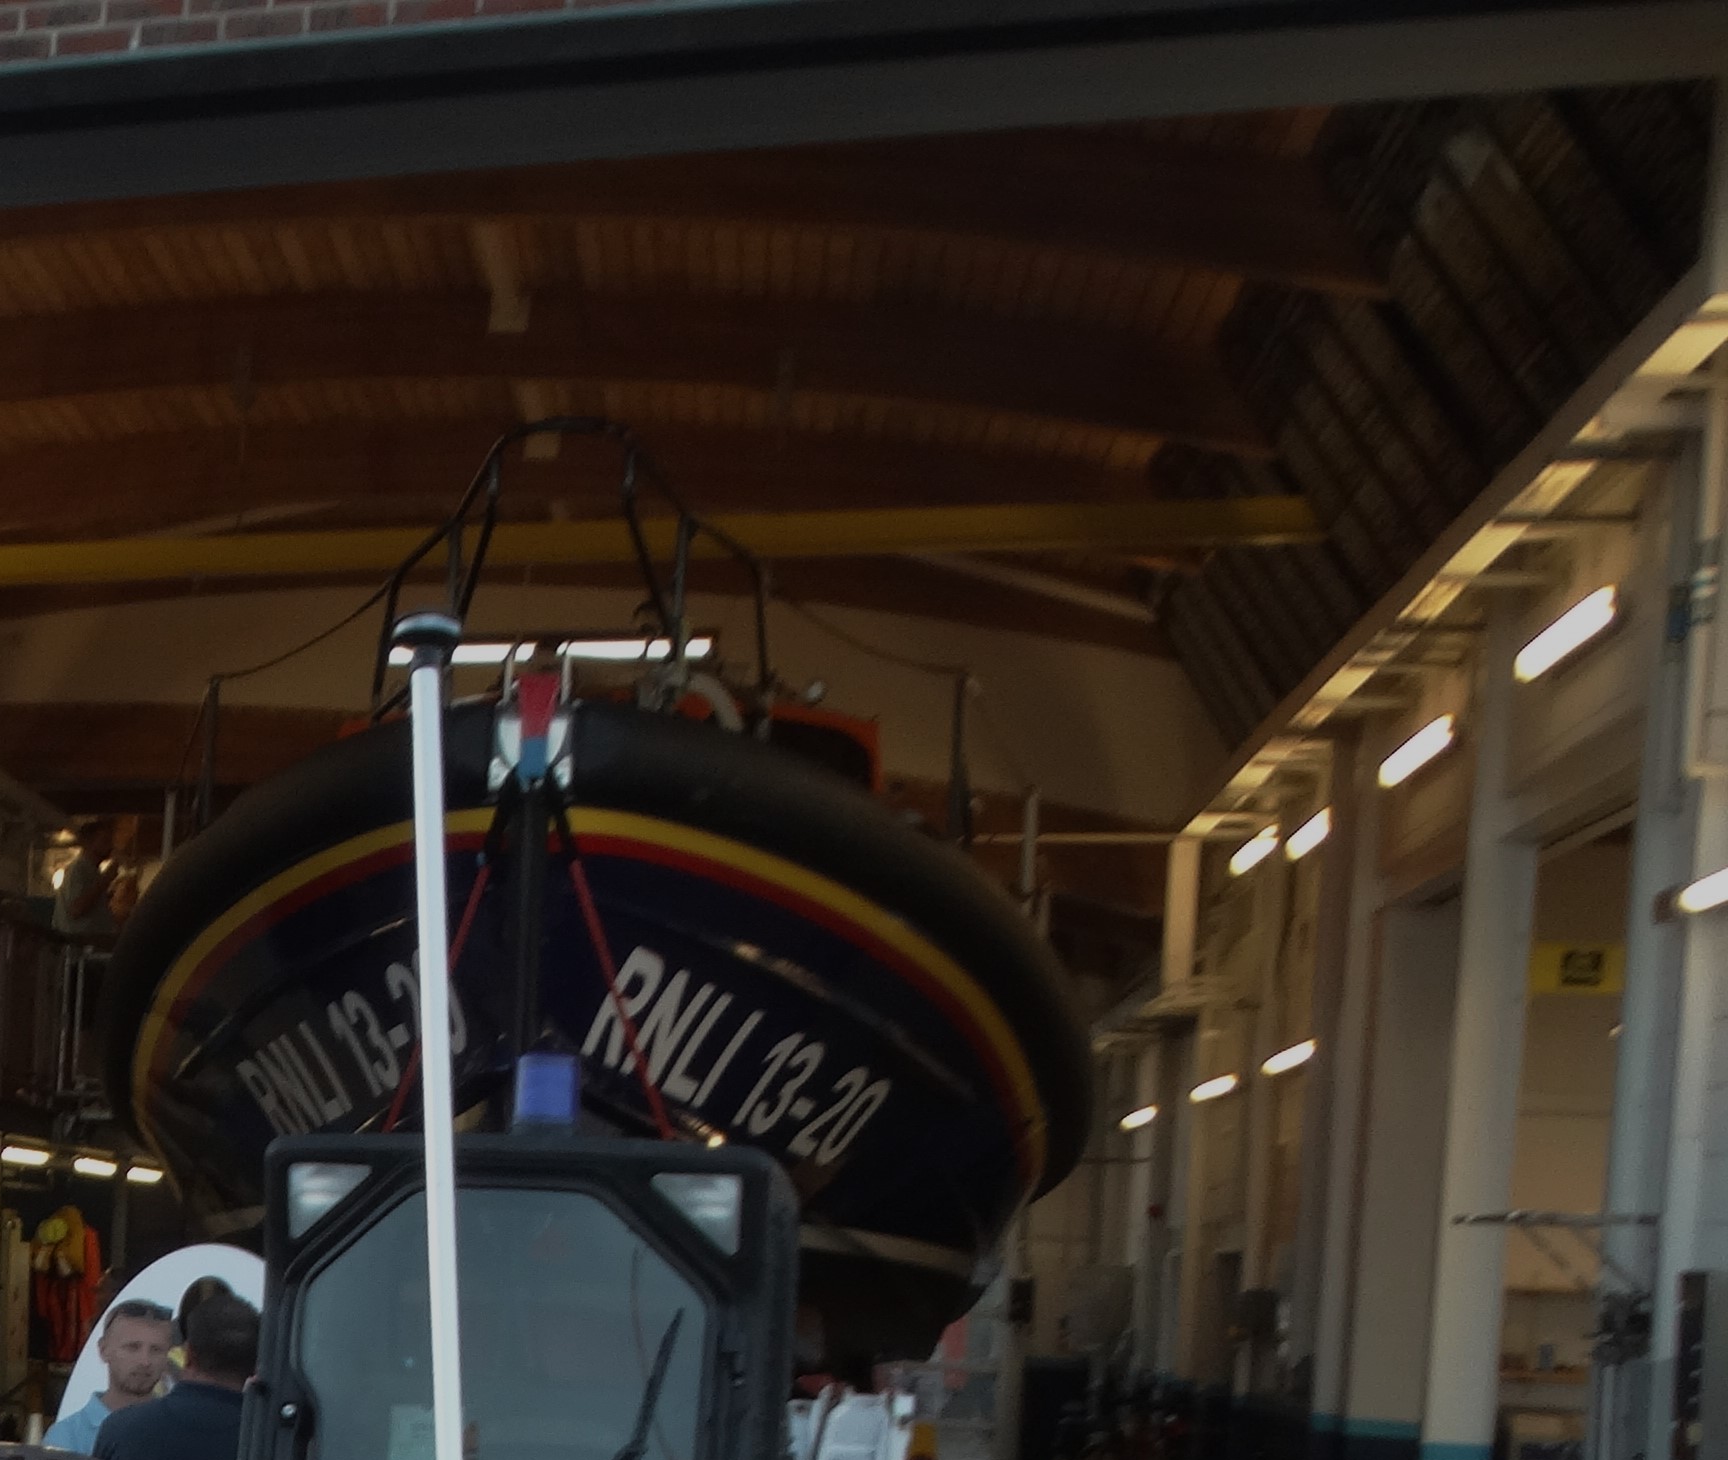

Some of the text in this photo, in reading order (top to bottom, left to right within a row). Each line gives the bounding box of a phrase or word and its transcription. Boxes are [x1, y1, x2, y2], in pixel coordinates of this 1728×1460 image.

[236, 1018, 352, 1136] RNLI
[580, 945, 892, 1166] RNLI 13-20
